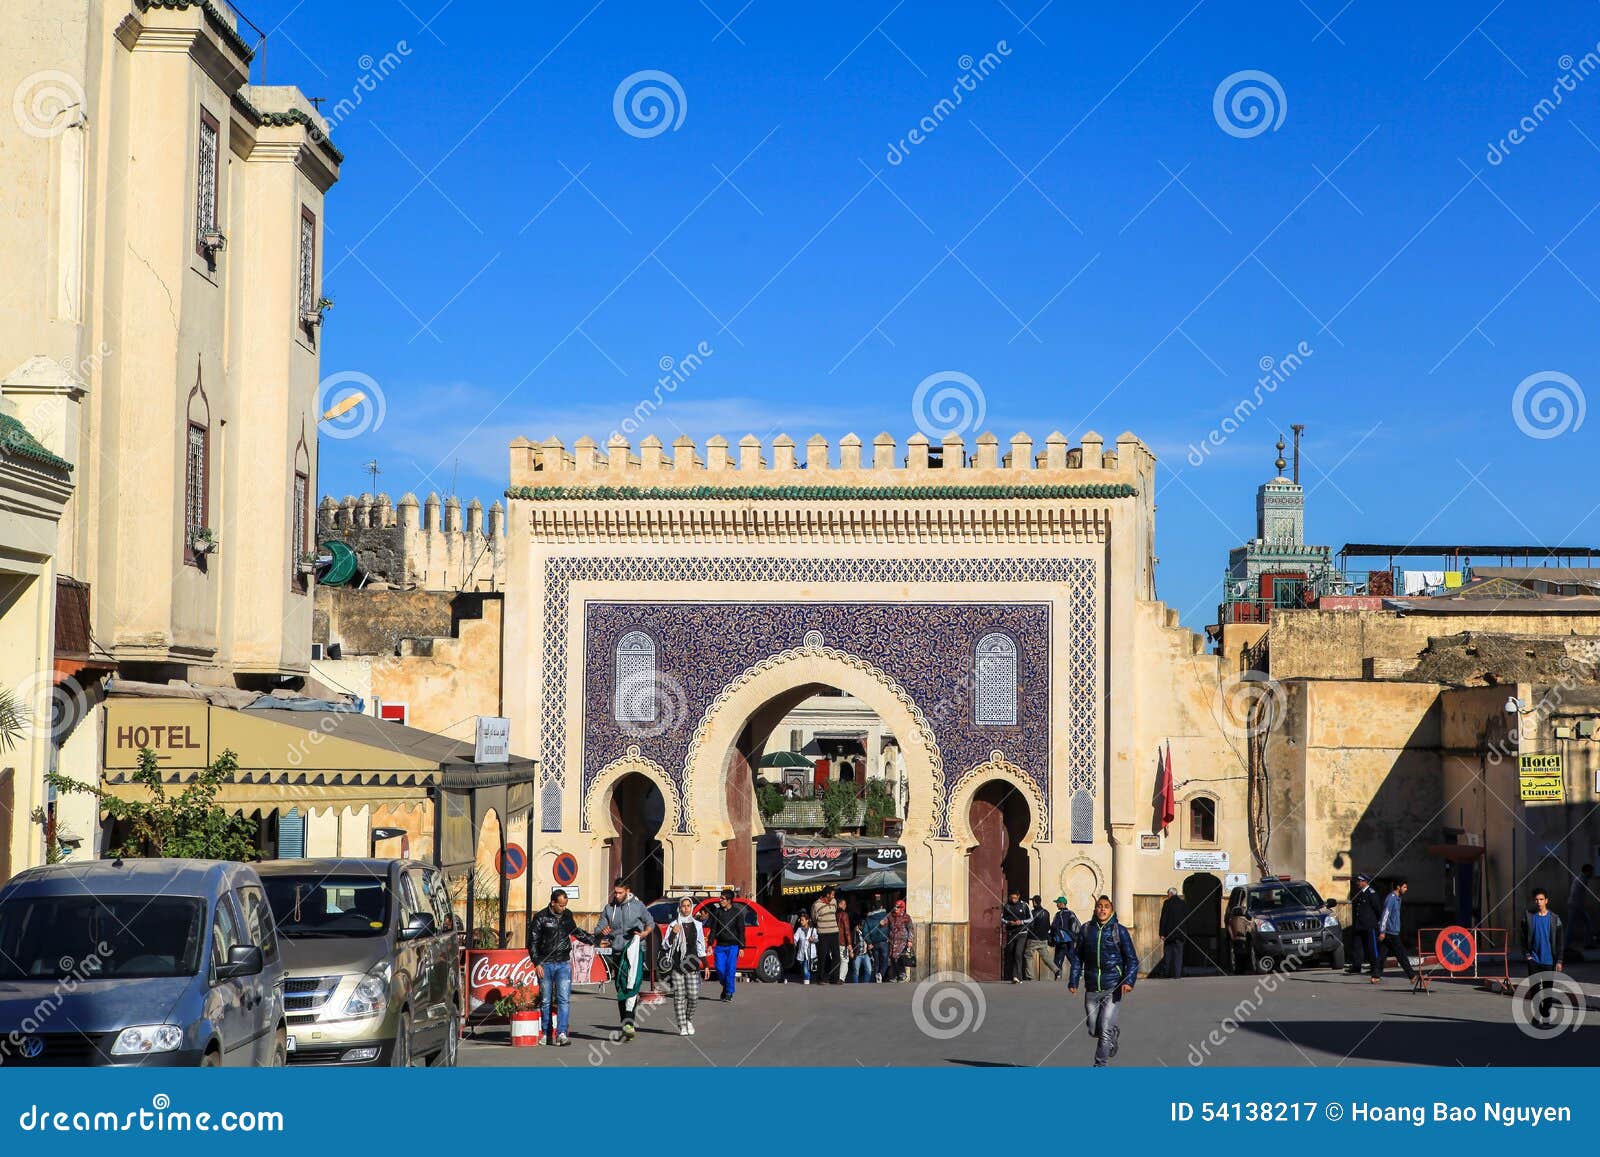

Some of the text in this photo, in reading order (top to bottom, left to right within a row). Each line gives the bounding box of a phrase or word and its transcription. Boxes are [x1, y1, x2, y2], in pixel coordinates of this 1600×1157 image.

[117, 726, 200, 748] HOTEL
[878, 849, 902, 859] zero
[797, 859, 828, 870] zero
